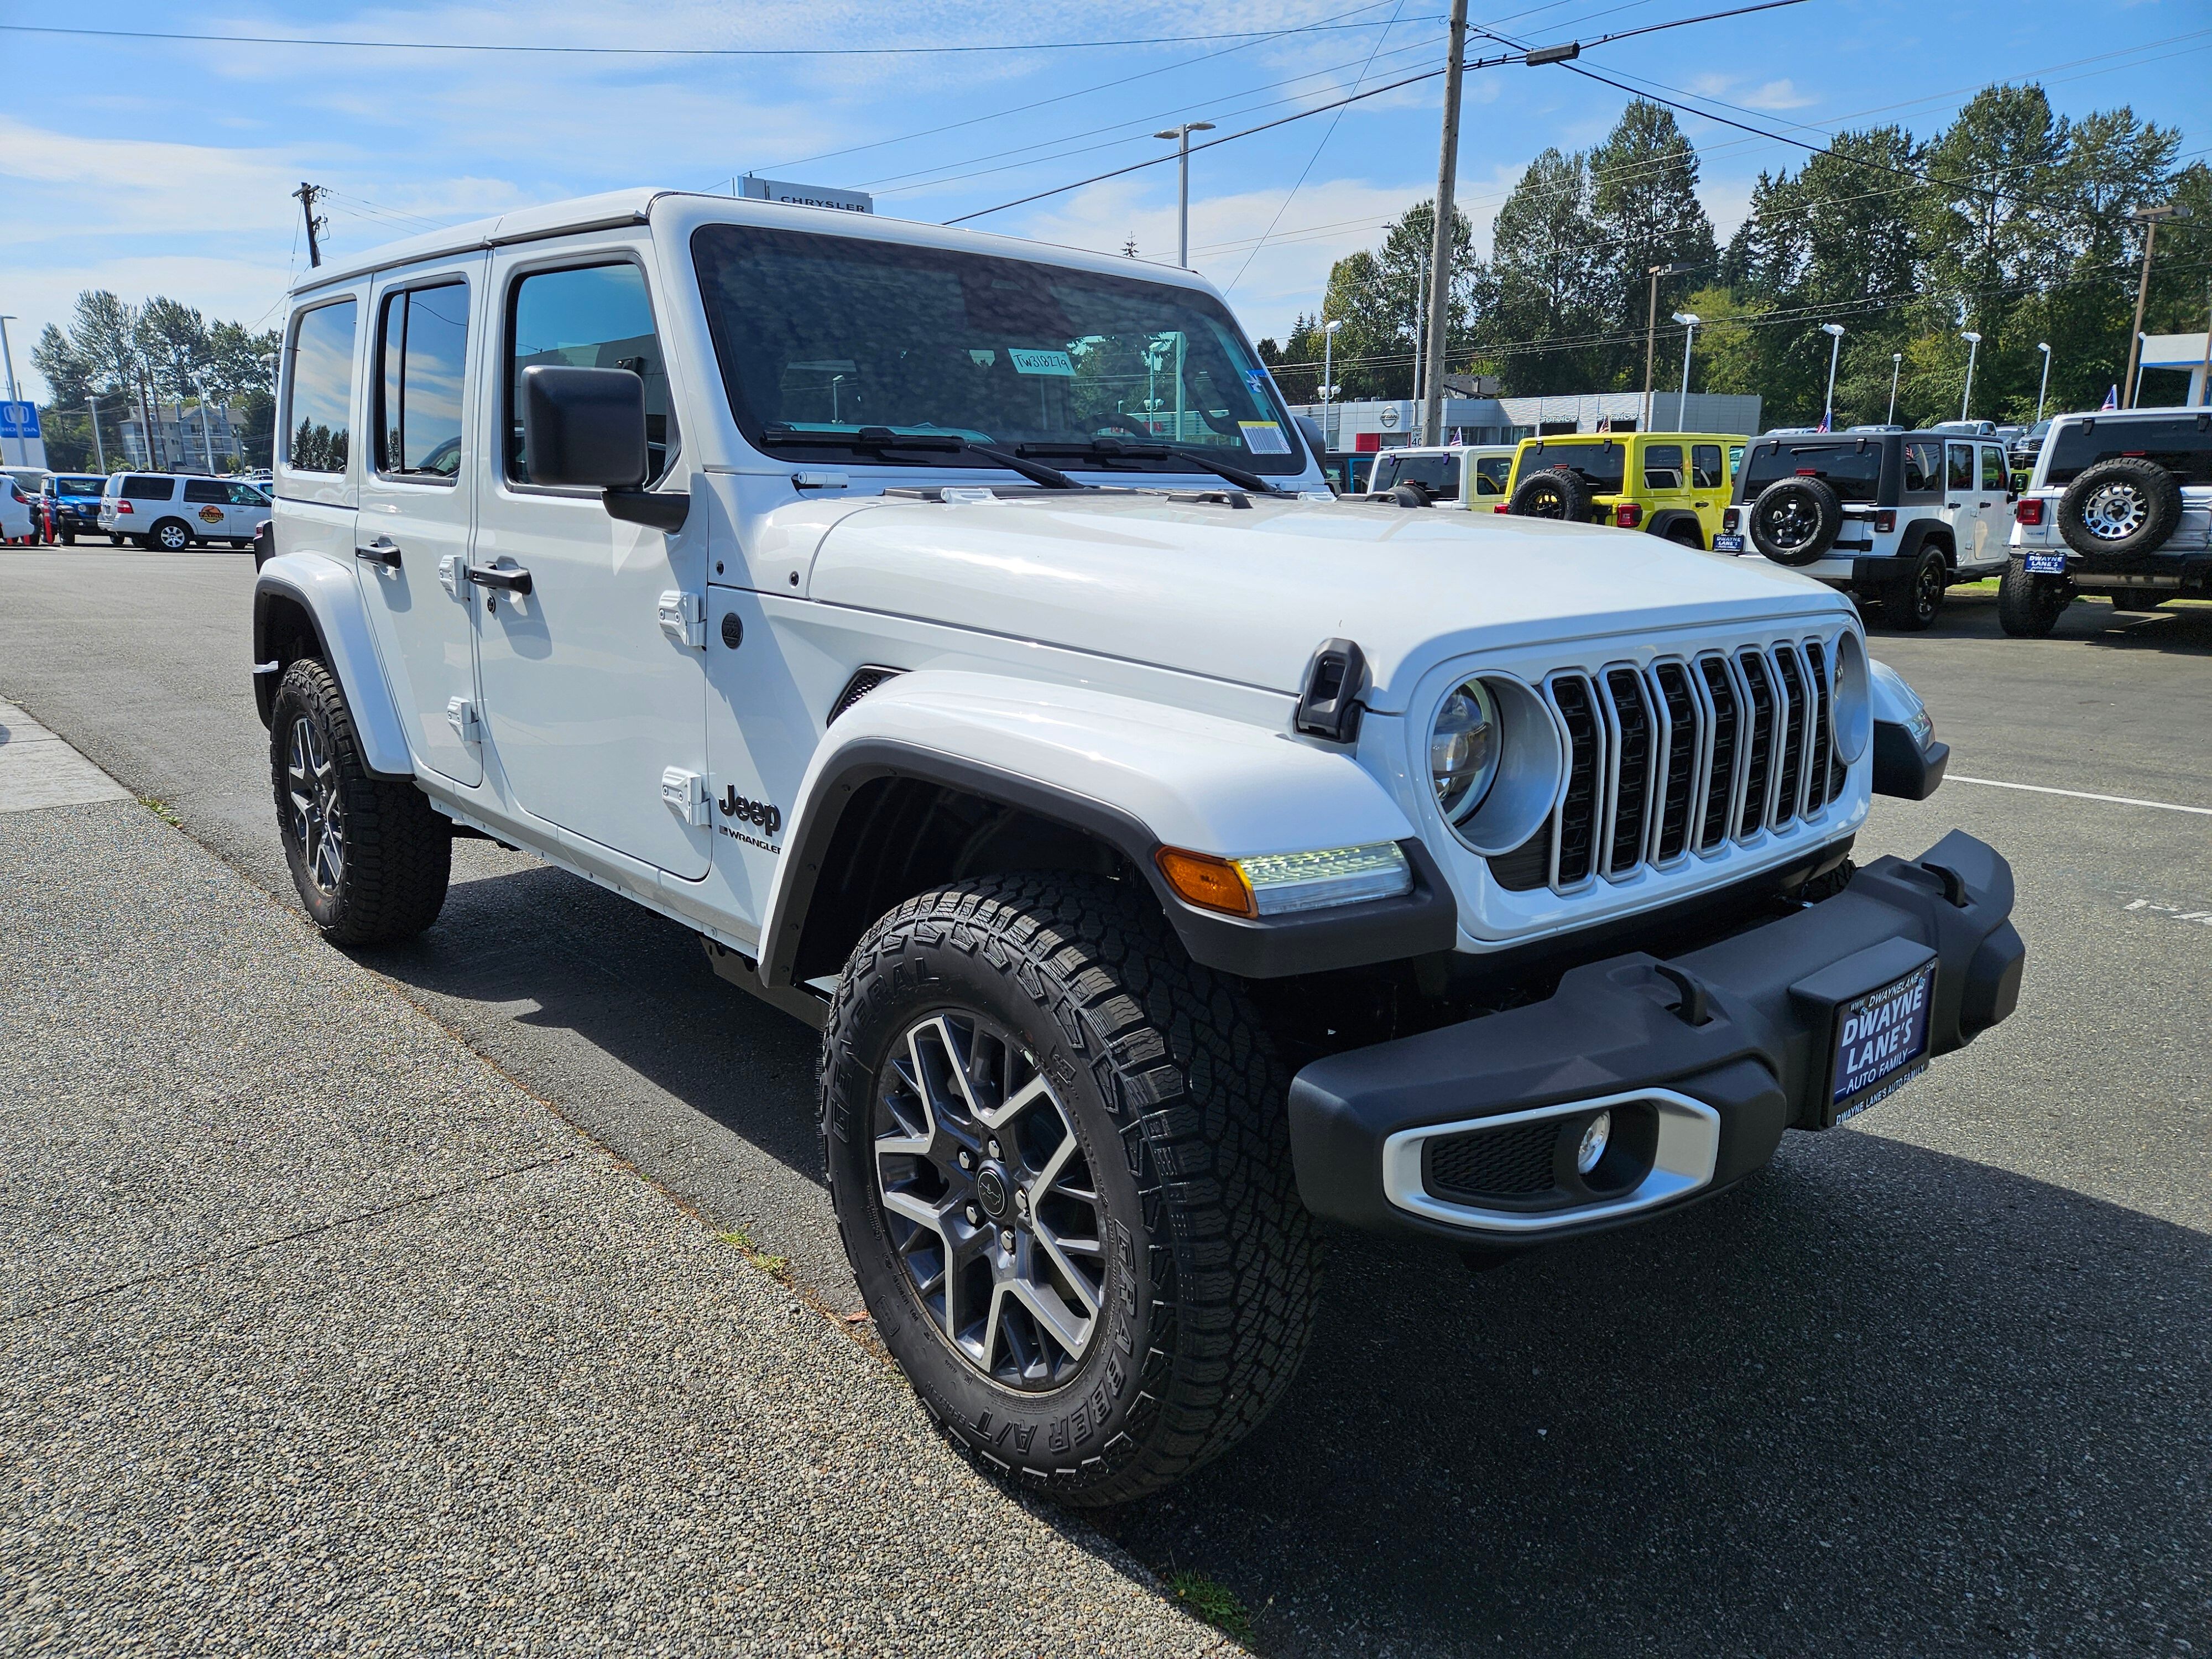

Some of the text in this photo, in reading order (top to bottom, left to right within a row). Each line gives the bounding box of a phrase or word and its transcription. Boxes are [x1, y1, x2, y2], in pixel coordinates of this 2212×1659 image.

[781, 196, 865, 212] CHRYSLER
[1013, 354, 1070, 371] TW318279
[1597, 412, 1639, 421] Srvice
[718, 782, 781, 837] Jeep
[1841, 986, 1924, 1047] DWAYNE
[1846, 1017, 1913, 1074] LANE'S
[1846, 1048, 1909, 1094] AUTO FAMILY
[1836, 1104, 1864, 1126] DWAYNE
[1887, 1079, 1905, 1095] AUTO
[1903, 1063, 1925, 1084] FAMILY
[1048, 1218, 1136, 1454] GRABBER
